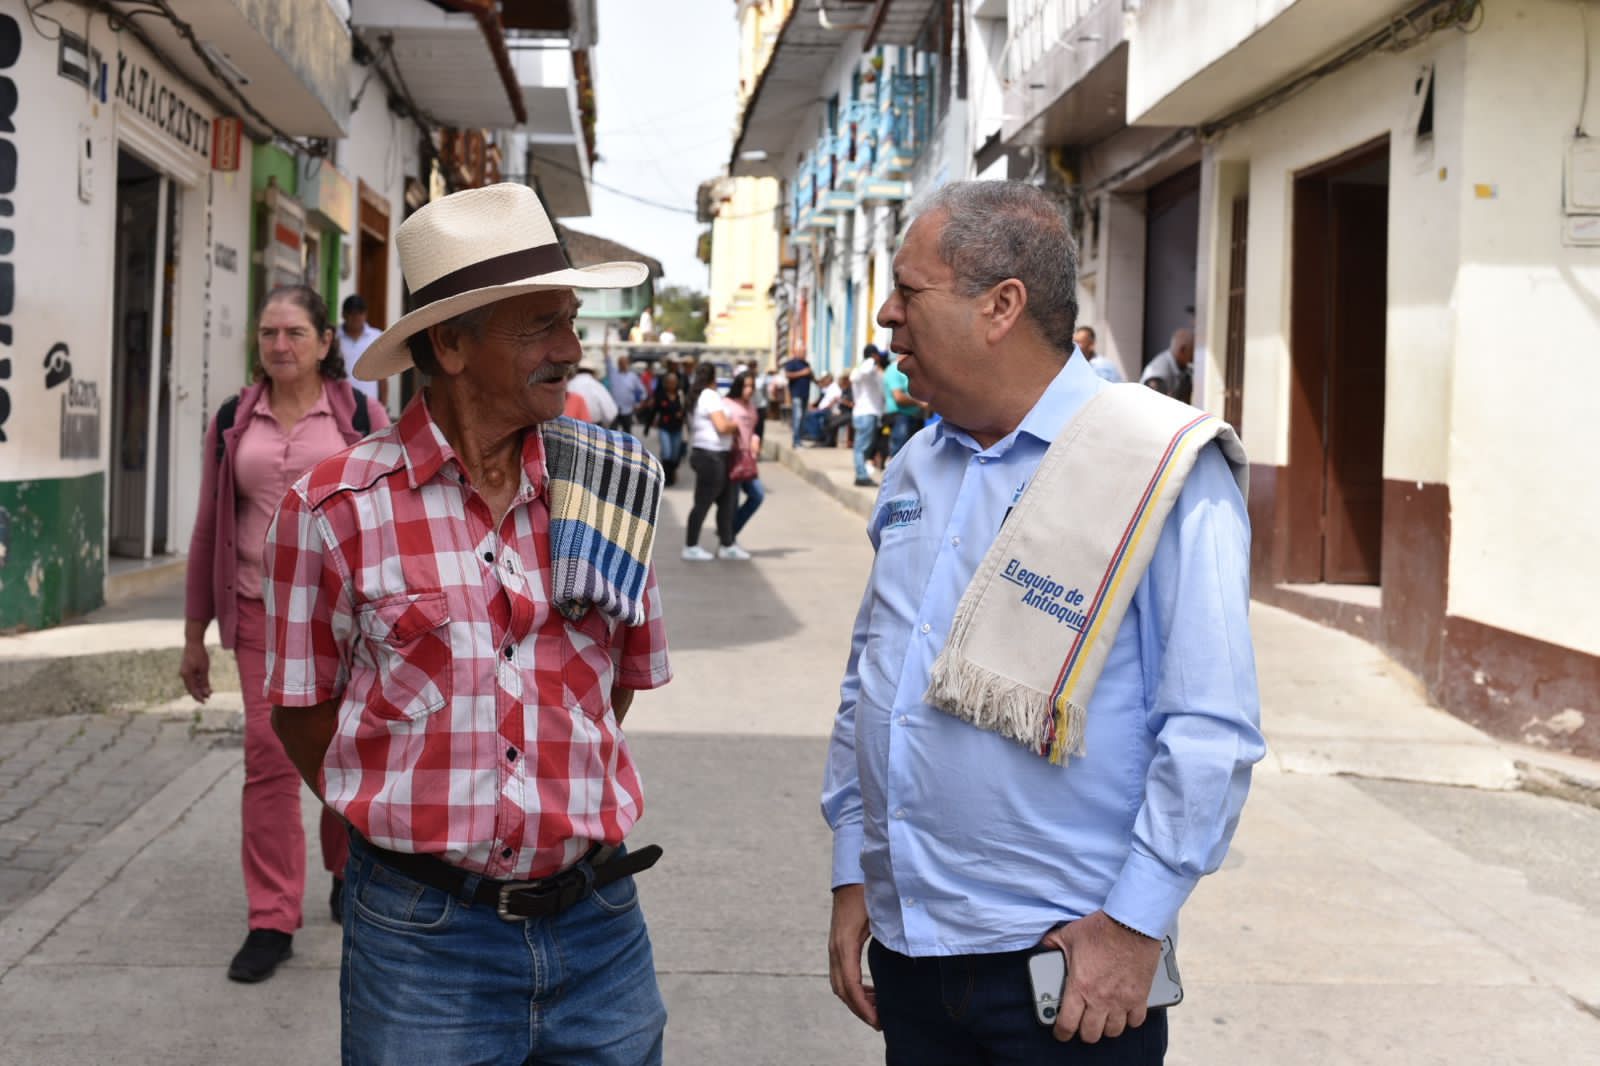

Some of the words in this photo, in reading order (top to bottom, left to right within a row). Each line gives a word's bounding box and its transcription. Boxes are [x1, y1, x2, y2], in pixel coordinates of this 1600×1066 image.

[1004, 558, 1020, 577] El
[1016, 568, 1064, 597] equipo
[1064, 588, 1084, 607] de
[1021, 588, 1087, 629] Antioquia
